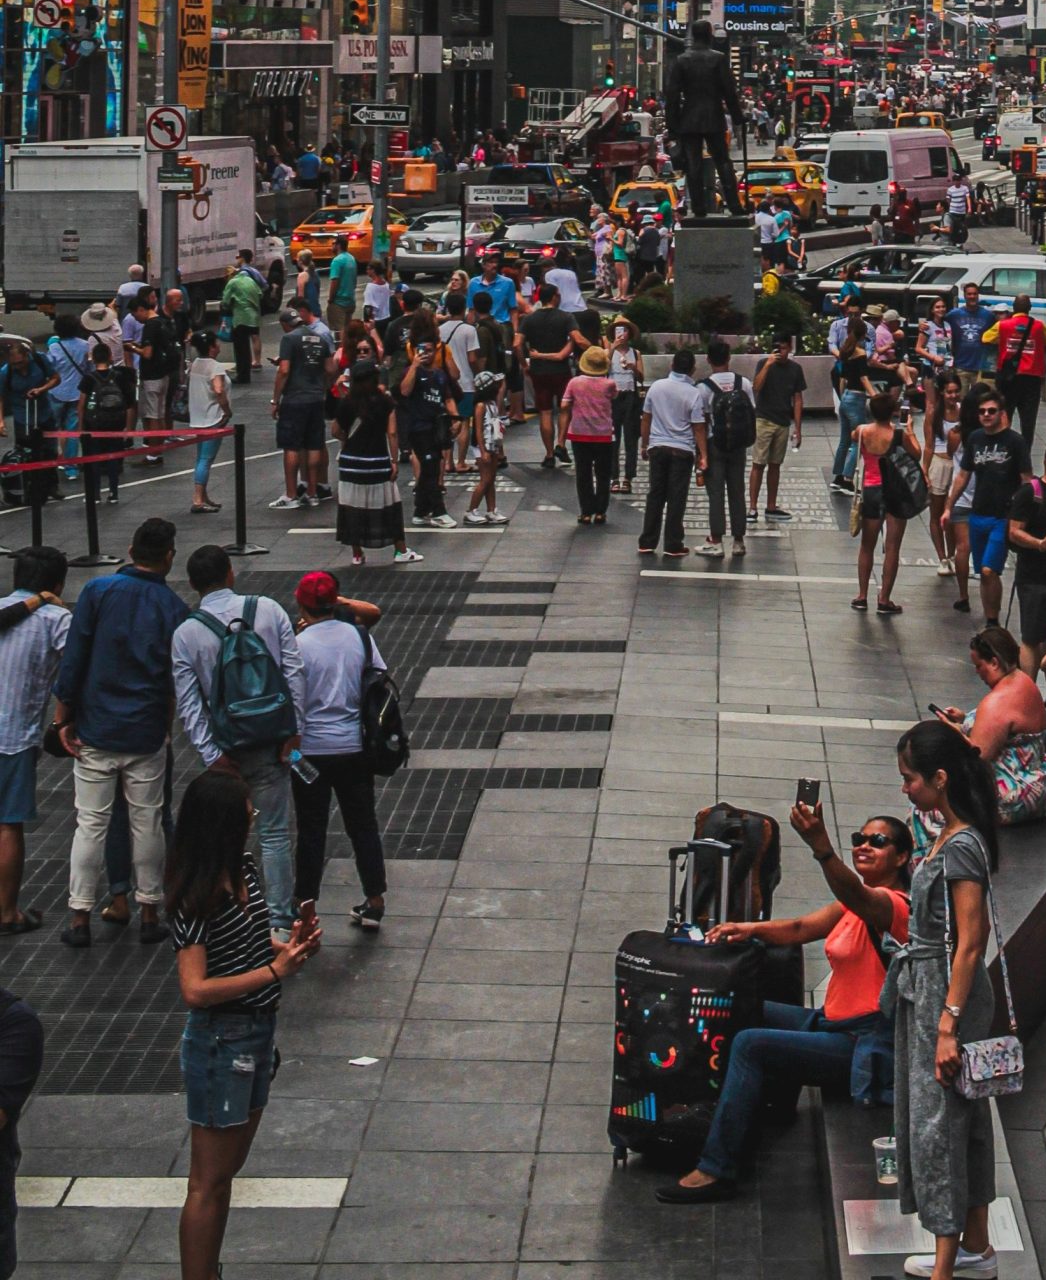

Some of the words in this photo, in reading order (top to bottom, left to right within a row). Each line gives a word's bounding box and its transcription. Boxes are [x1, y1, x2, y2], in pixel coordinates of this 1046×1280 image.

[181, 7, 207, 37] LION
[725, 20, 769, 31] Cousins
[179, 37, 209, 73] KING
[348, 39, 363, 58] U.S.
[250, 70, 300, 97] FOREVER
[358, 110, 376, 120] ONE
[383, 110, 403, 120] WAY
